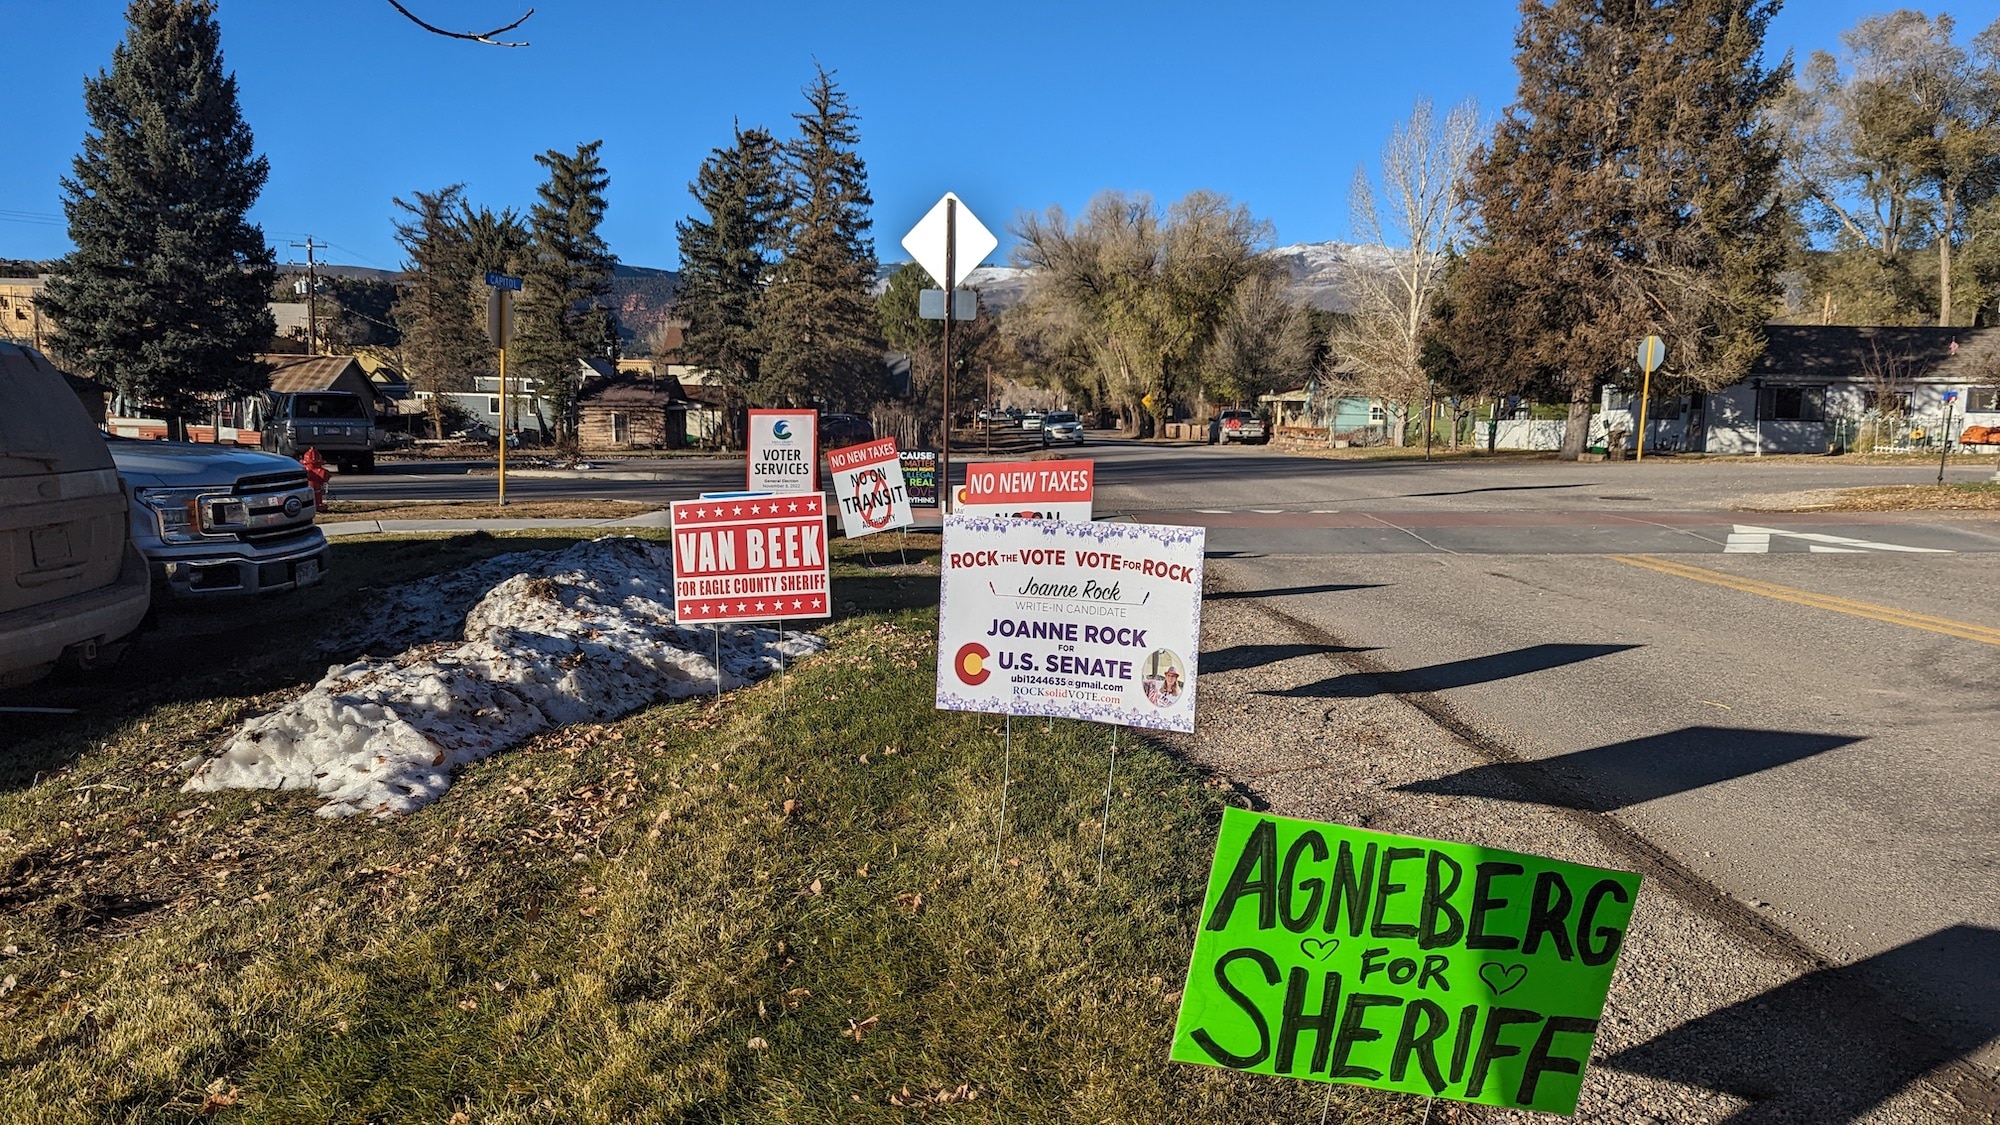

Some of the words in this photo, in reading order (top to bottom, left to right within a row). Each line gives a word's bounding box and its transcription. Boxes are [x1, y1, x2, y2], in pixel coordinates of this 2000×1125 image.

[490, 275, 518, 289] CAPITOL
[763, 449, 800, 460] VOTER
[831, 455, 846, 468] NO
[847, 449, 867, 464] NEW
[868, 442, 895, 459] TAXES
[897, 452, 935, 460] CAUSE:
[755, 463, 809, 475] SERVICES
[850, 471, 868, 487] NO
[870, 466, 887, 483] ON
[908, 487, 934, 496] OVE
[970, 473, 995, 494] NO
[999, 472, 1036, 493] NEW
[1040, 470, 1088, 492] TAXES
[842, 486, 903, 514] TRANSIT
[862, 514, 896, 529] AUTHORITY
[678, 530, 736, 573] VAN
[746, 525, 822, 570] BEEK
[950, 550, 999, 569] ROCK
[1000, 553, 1018, 563] THE
[1020, 550, 1065, 566] VOTE
[1075, 551, 1122, 571] VOTE
[1123, 560, 1141, 571] FOR
[1142, 559, 1193, 584] ROCK
[677, 581, 696, 597] FOR
[700, 579, 730, 596] EAGLE
[734, 576, 777, 594] COUNTY
[781, 574, 826, 591] SHERIFF
[1018, 576, 1078, 598] Joanne
[1082, 580, 1121, 601] Rock
[1015, 601, 1064, 614] WRITE-IN
[1066, 603, 1126, 618] CANDIDATE
[987, 619, 1078, 642] JOANNE
[1084, 626, 1147, 648] ROCK
[1058, 644, 1075, 652] FOR
[998, 652, 1039, 672] U.S.
[1046, 656, 1133, 680] SENATE
[1011, 676, 1123, 692] ubi1244635@gmail.com
[1013, 686, 1121, 704] ROCKsolidVOTE.com
[1206, 818, 1629, 968] AGNEBERG
[1360, 947, 1450, 992] FOR
[1190, 947, 1598, 1106] SHERIFF
